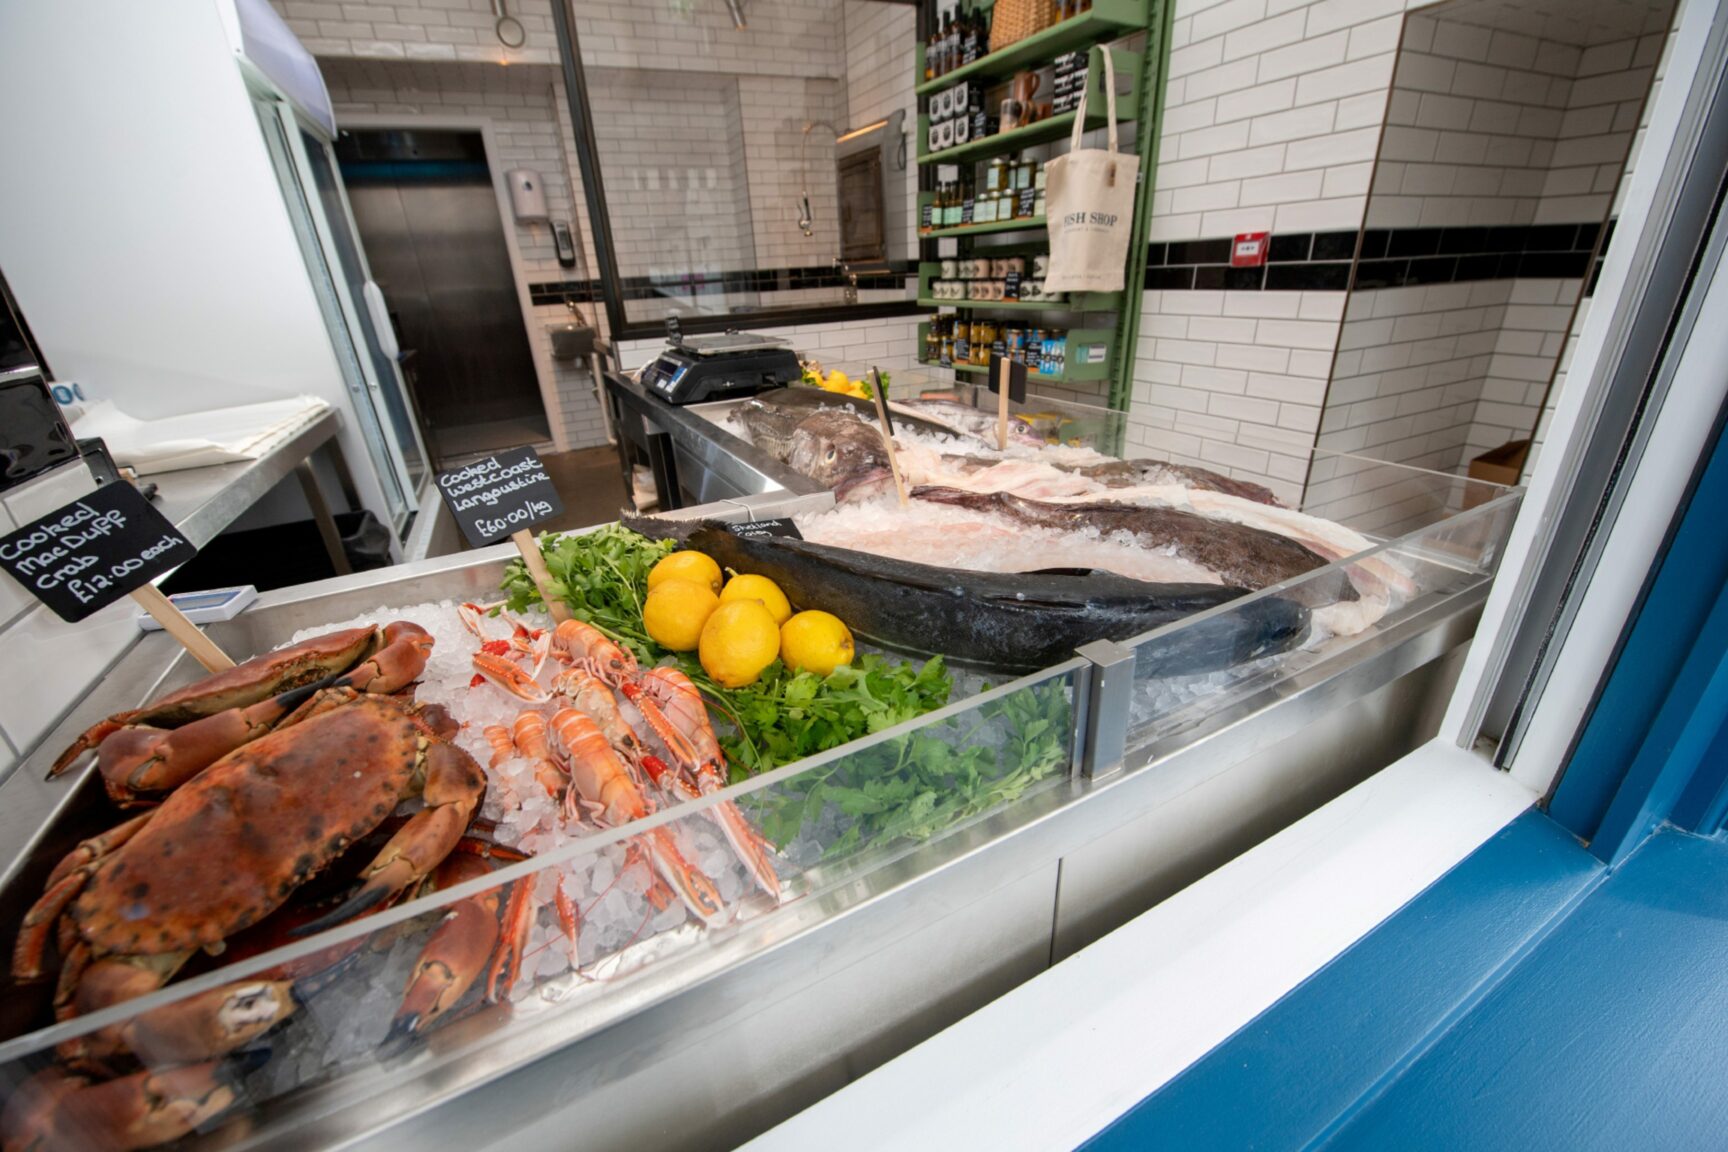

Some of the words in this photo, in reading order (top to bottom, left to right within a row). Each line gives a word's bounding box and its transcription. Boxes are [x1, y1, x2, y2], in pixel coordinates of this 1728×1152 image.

[1089, 212, 1118, 226] SHOP
[440, 457, 501, 487] Cooked
[0, 502, 100, 560] Cooked
[36, 555, 99, 589] Crab
[67, 558, 144, 603] £12.00
[140, 535, 183, 561] each
